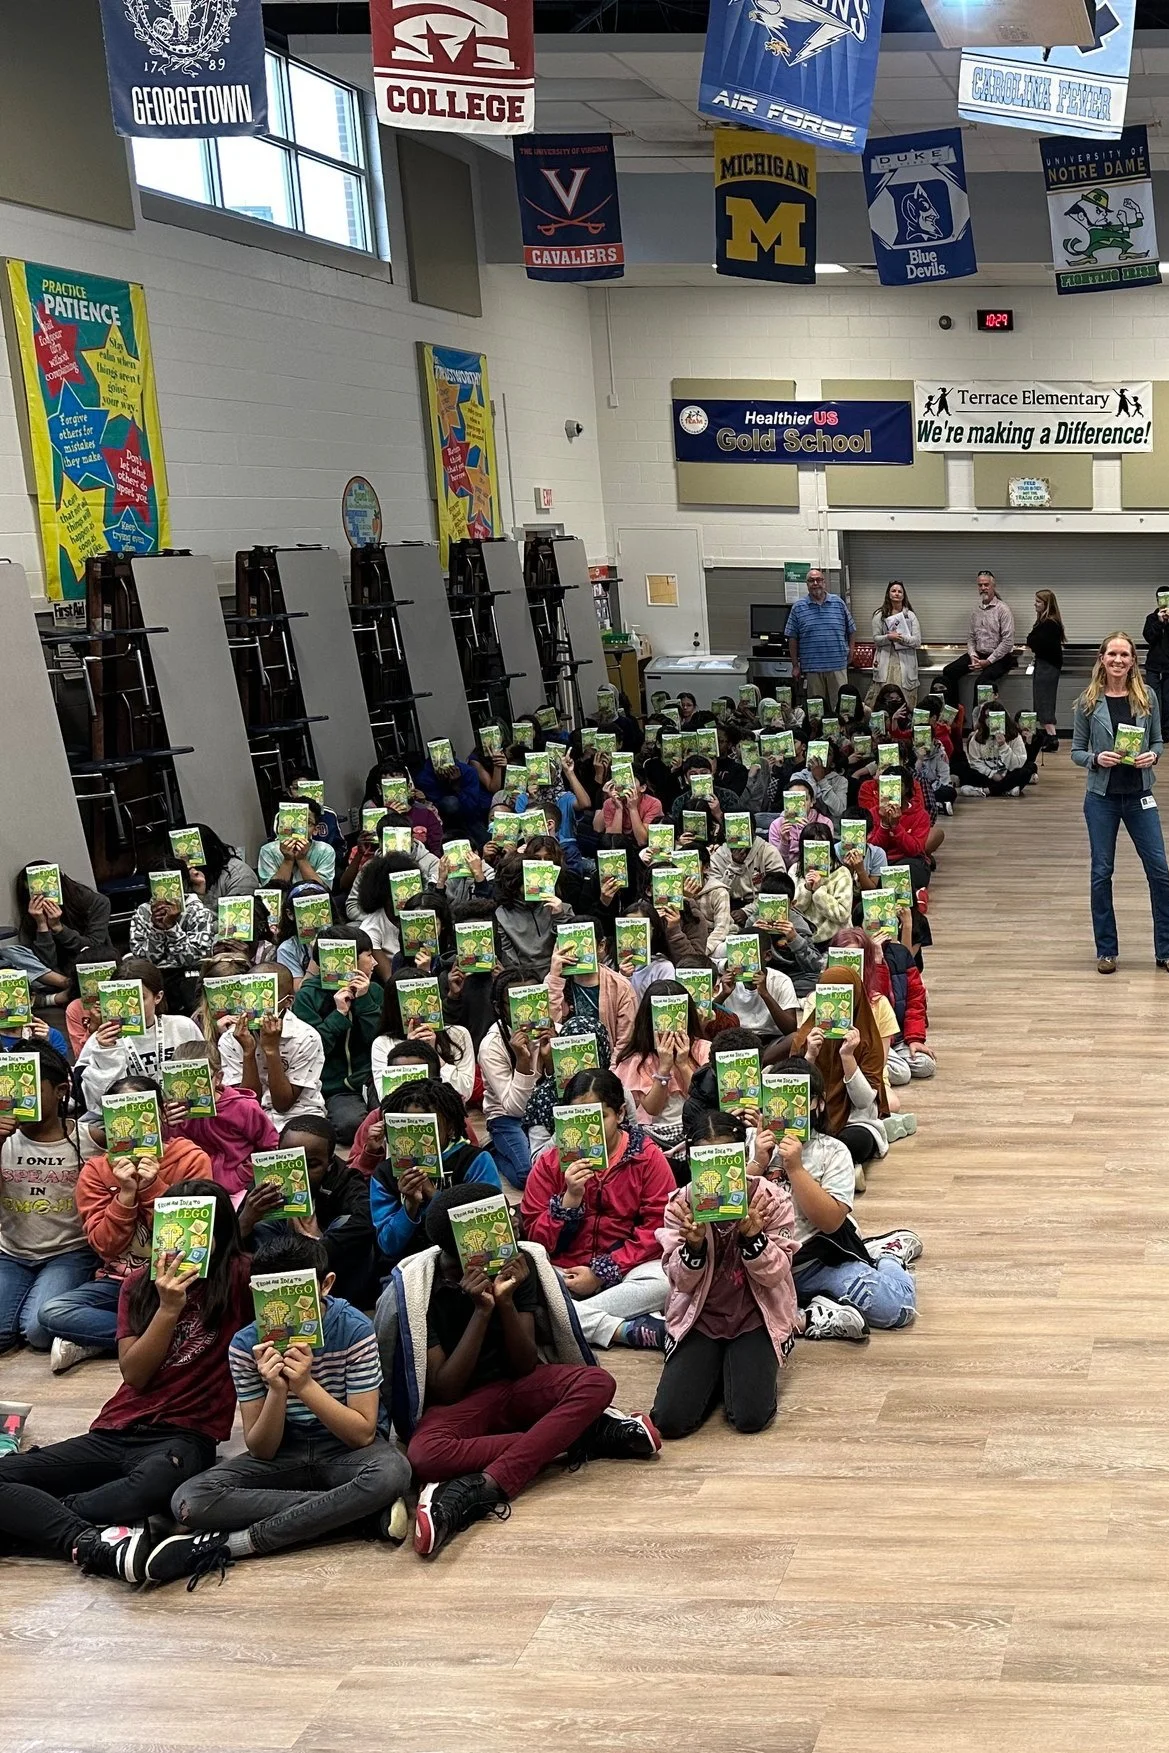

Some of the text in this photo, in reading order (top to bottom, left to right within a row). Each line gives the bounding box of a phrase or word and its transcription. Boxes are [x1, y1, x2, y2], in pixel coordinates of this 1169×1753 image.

[144, 58, 226, 73] 17 89
[972, 66, 1112, 121] CAROLINA FEVER
[131, 84, 253, 125] GEORGETOWN
[387, 84, 525, 123] COLLEGE
[712, 89, 857, 142] AIR FORCE
[534, 147, 571, 155] UNIVERSITY
[880, 149, 942, 164] DUKE
[1047, 146, 1144, 166] UNIVERSITY OF
[720, 152, 810, 189] MICHIGAN
[1048, 157, 1146, 182] NOTRE DAME
[540, 167, 591, 216] V
[725, 196, 806, 267] M
[532, 246, 618, 266] CAVALIERS
[908, 249, 938, 265] Blue
[906, 261, 947, 279] Devils
[1060, 265, 1157, 287] FIGHTING IRISH
[42, 279, 87, 299] PRACTICE
[43, 293, 121, 326] PATIENCE
[985, 313, 1008, 327] 10:29
[109, 336, 124, 355] Stay
[97, 362, 118, 380] things
[116, 357, 137, 370] when
[107, 381, 128, 399] going
[102, 395, 119, 408] your
[958, 389, 1111, 410] Terrace Elementary
[59, 411, 88, 426] Forgive
[59, 425, 93, 441] others for
[716, 428, 872, 453] Gold School
[917, 420, 1152, 450] We're making a Difference!
[63, 440, 96, 454] mistakes
[64, 456, 81, 468] they
[120, 457, 130, 470] let
[116, 484, 135, 497] upset
[117, 472, 148, 491] others do
[60, 510, 74, 524] that
[54, 601, 85, 618] First Aid
[16, 1156, 66, 1166] I ONLY
[713, 1156, 741, 1166] LEGO
[1, 1168, 78, 1184] SPEAK
[30, 1187, 47, 1196] IN
[175, 1209, 209, 1219] LEGO
